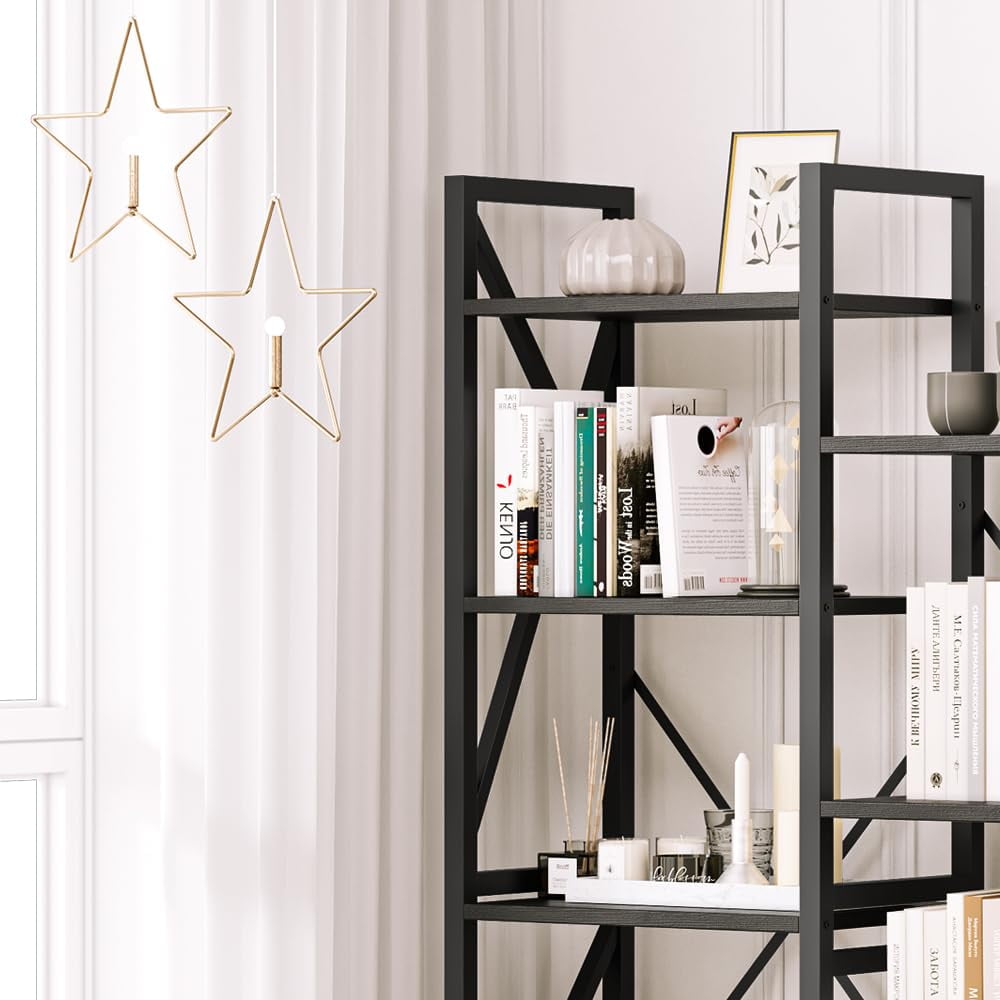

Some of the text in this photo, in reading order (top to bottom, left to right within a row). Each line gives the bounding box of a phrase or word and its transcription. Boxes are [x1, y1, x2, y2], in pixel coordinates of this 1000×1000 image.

[931, 605, 940, 692] ДАНТЕ АЛИГЬЕРИ
[929, 947, 940, 996] ЗАБОТА
